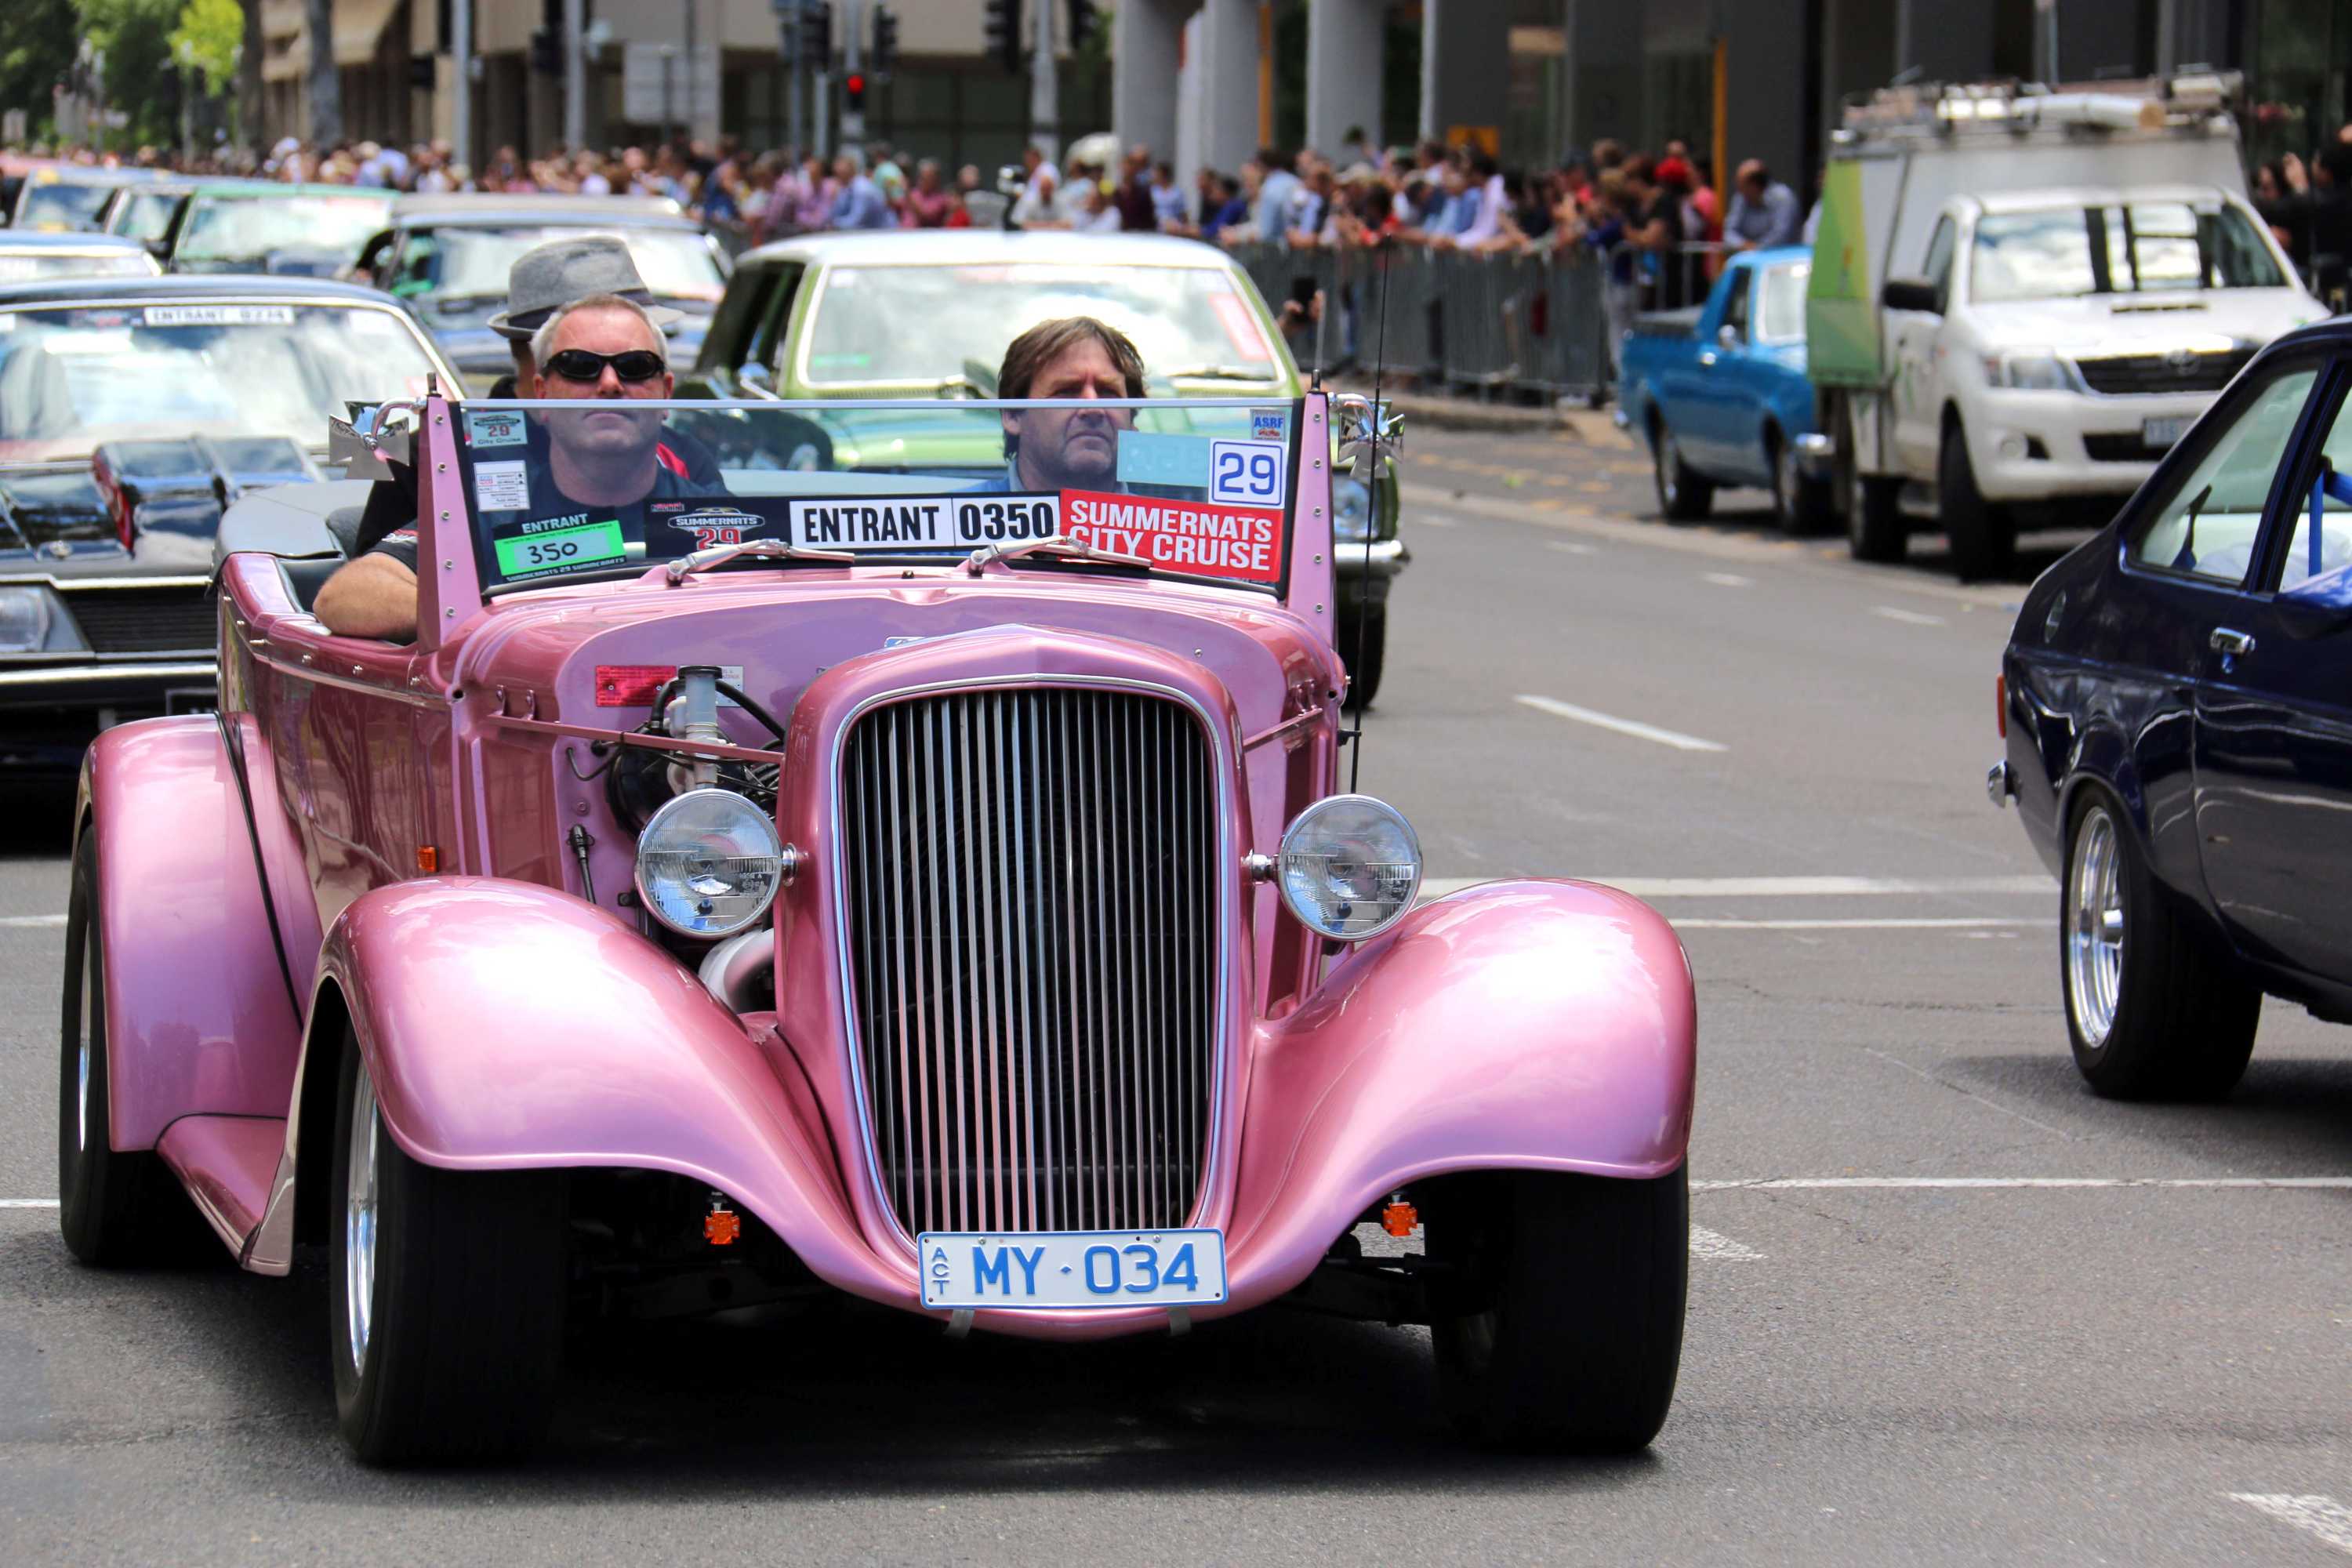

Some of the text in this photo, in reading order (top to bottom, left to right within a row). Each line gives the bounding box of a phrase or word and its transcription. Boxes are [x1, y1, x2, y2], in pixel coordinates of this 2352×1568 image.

[488, 425, 510, 437] 29
[1254, 416, 1284, 428] ASRF
[1218, 452, 1276, 496] 29
[521, 514, 588, 534] ENTRANT
[676, 517, 758, 526] SUMMERNATS
[802, 503, 1054, 543] ENTRANT 0350
[1069, 499, 1272, 543] SUMMERNATS
[527, 542, 579, 564] 350
[694, 526, 742, 551] 29
[1152, 533, 1272, 571] CRUISE
[931, 1246, 951, 1295] ACT
[1083, 1242, 1199, 1294] 034
